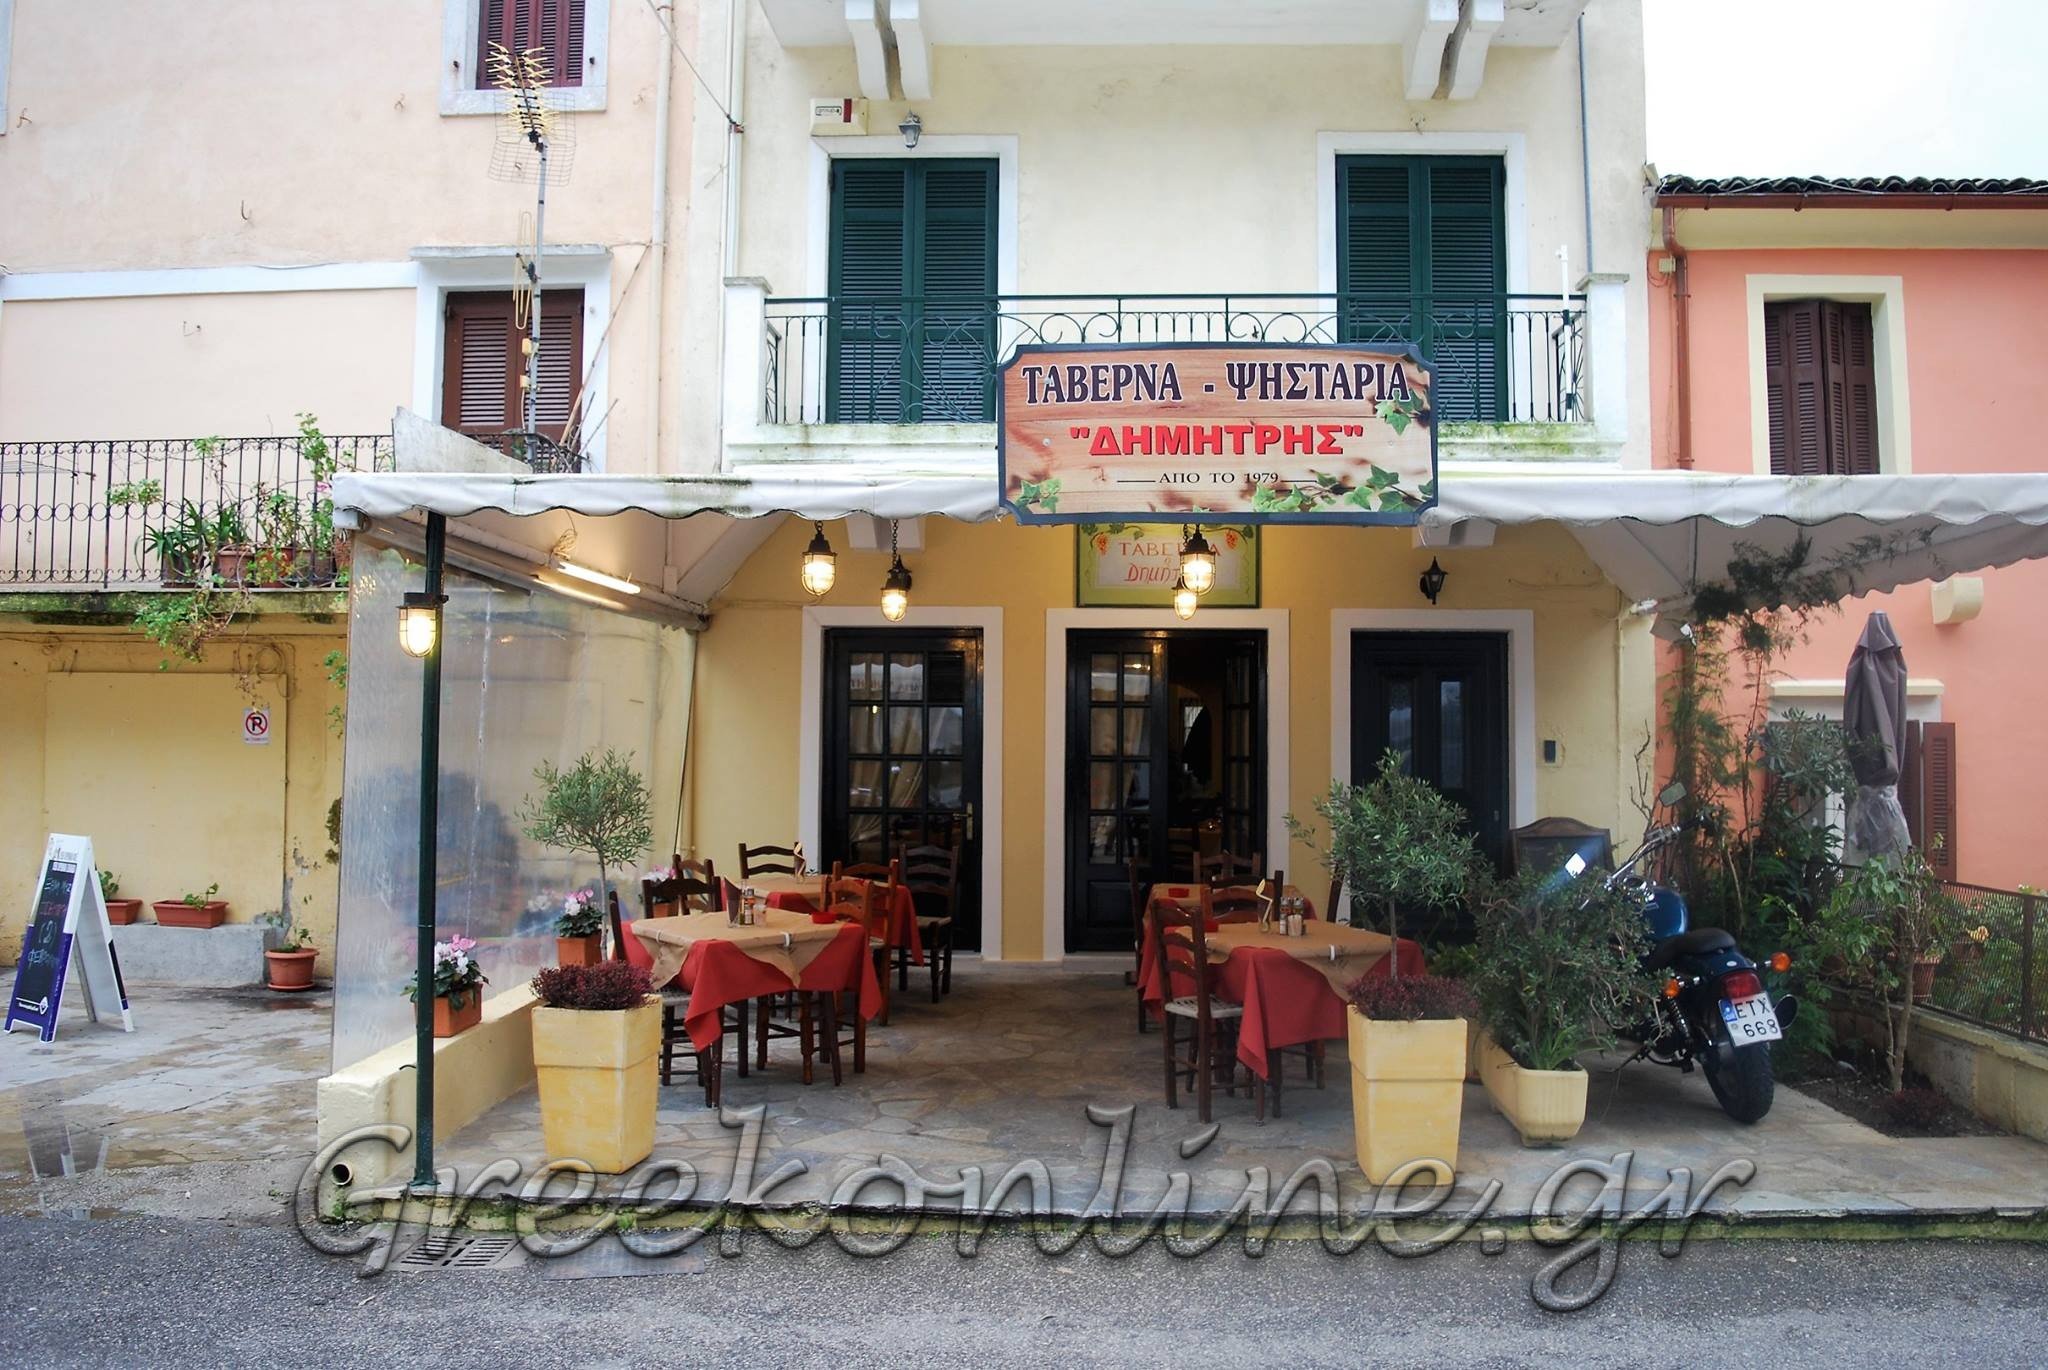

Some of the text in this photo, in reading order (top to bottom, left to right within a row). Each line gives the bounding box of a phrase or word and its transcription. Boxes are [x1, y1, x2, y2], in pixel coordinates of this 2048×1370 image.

[1022, 362, 1183, 404] ΤΑΒΕΡΝΑ
[1225, 362, 1411, 401] ΨΗΣΤΑΡΙΑ
[1069, 424, 1364, 456] "ΔΗΜΗΤΡΗΣ"
[1159, 472, 1279, 485] ΑΠΟ ΤΟ 1979
[1735, 998, 1770, 1019] ETX
[1743, 1019, 1778, 1037] 668
